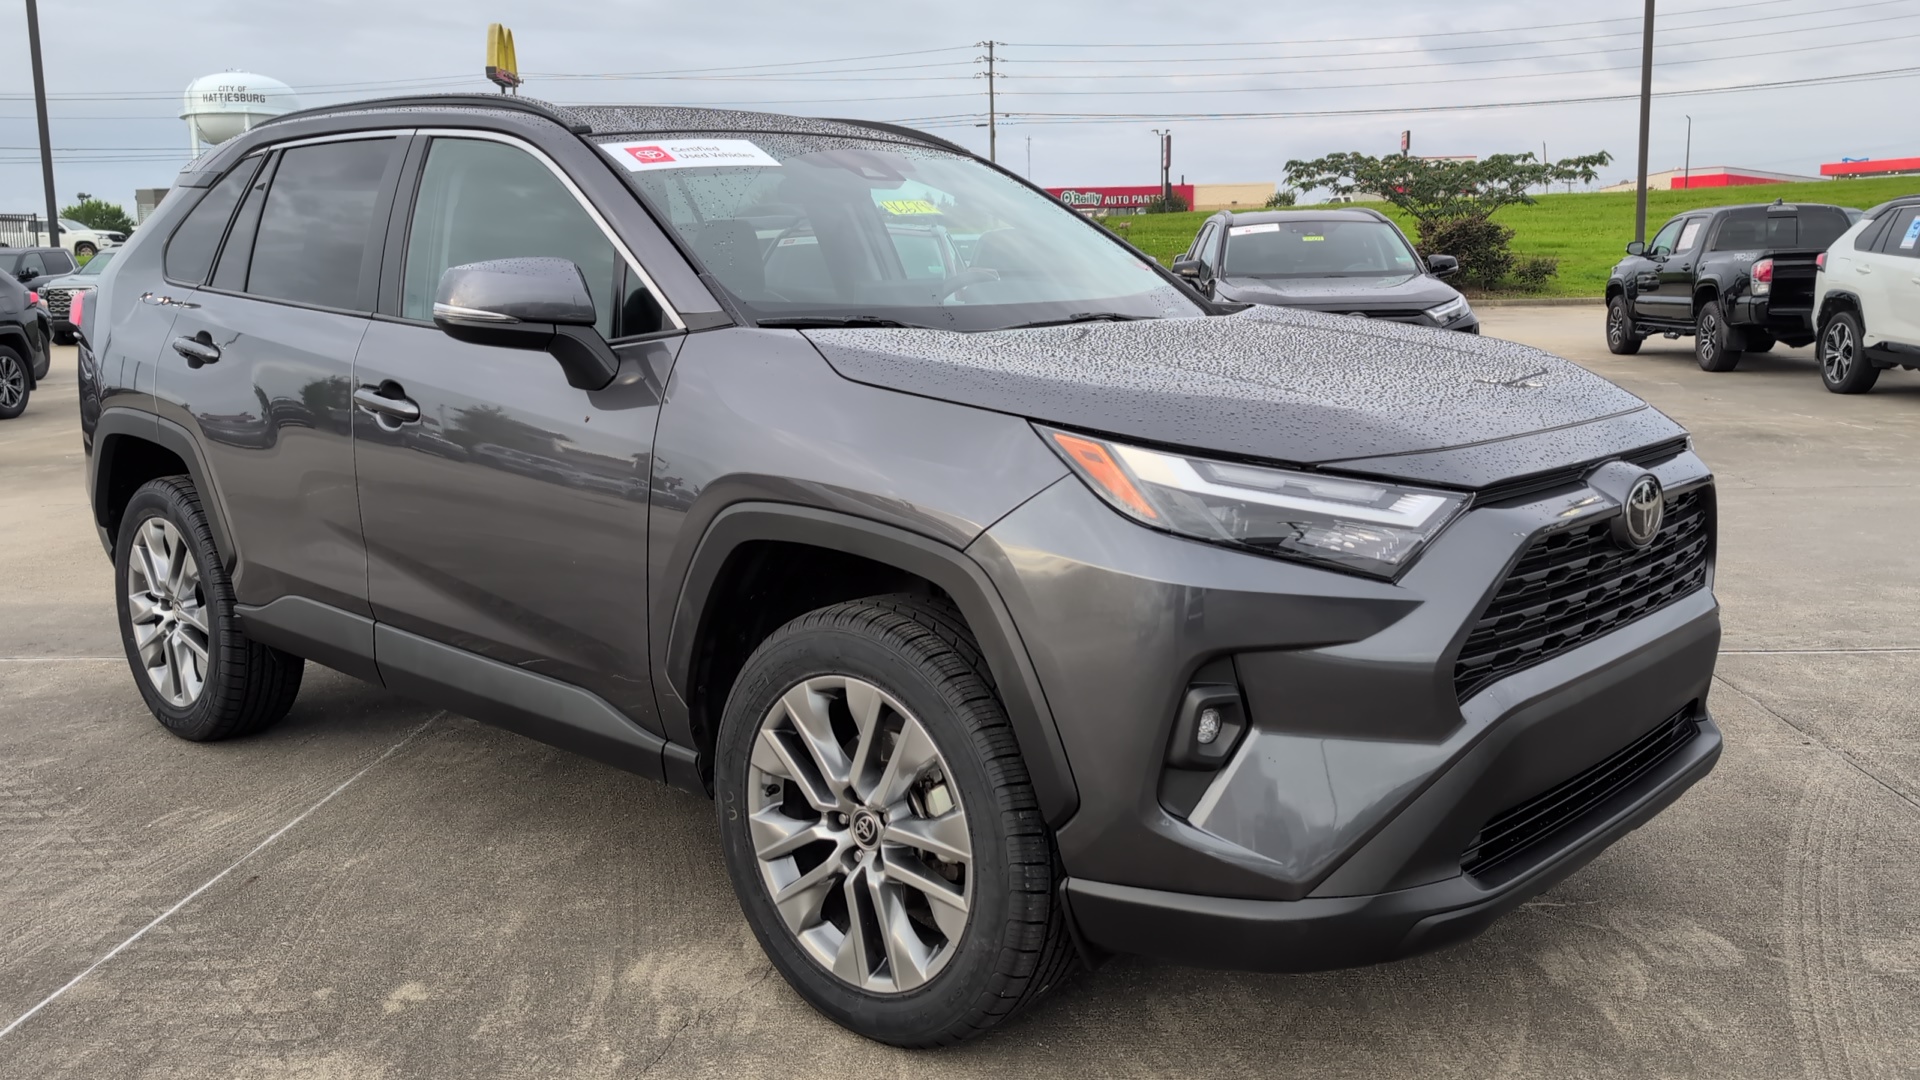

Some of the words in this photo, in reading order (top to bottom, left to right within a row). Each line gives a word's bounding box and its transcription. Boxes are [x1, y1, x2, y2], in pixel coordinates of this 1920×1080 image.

[202, 92, 266, 103] HATTIESBURG
[1061, 190, 1102, 206] O'Reilly
[1104, 195, 1129, 205] AUTO
[1131, 194, 1162, 204] PARTS
